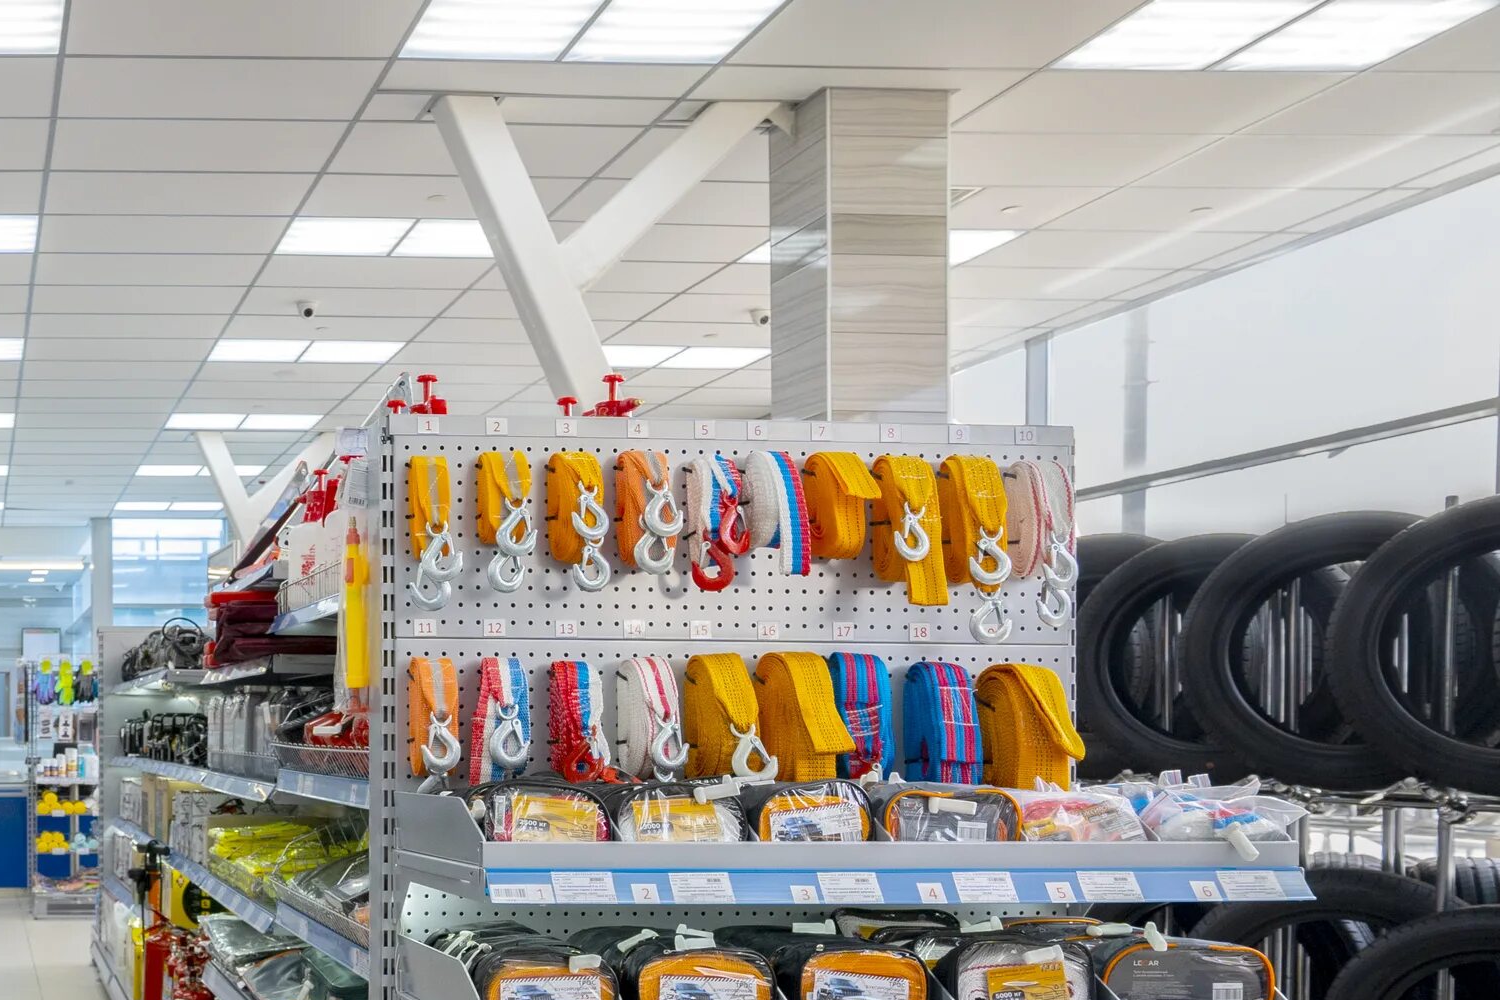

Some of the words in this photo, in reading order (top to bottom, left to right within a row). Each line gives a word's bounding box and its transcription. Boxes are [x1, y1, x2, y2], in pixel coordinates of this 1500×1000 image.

[426, 420, 432, 431] 1
[493, 421, 500, 432] 2
[563, 423, 570, 434] 3
[633, 423, 641, 435] 4
[701, 424, 708, 436] 5
[754, 425, 762, 436] 6
[818, 425, 825, 437] 7
[887, 427, 895, 438] 8
[955, 428, 963, 440] 9
[1019, 430, 1033, 441] 10
[418, 622, 432, 633] 11
[487, 622, 502, 634] 12
[559, 623, 574, 634] 13
[627, 623, 641, 635] 14
[694, 624, 708, 635] 15
[761, 625, 776, 637] 16
[836, 625, 851, 637] 17
[913, 626, 928, 638] 18
[538, 888, 545, 900] 1
[643, 888, 651, 899] 2
[800, 889, 810, 900] 3
[928, 888, 937, 899] 4
[1056, 887, 1066, 898] 5
[1202, 886, 1212, 897] 6
